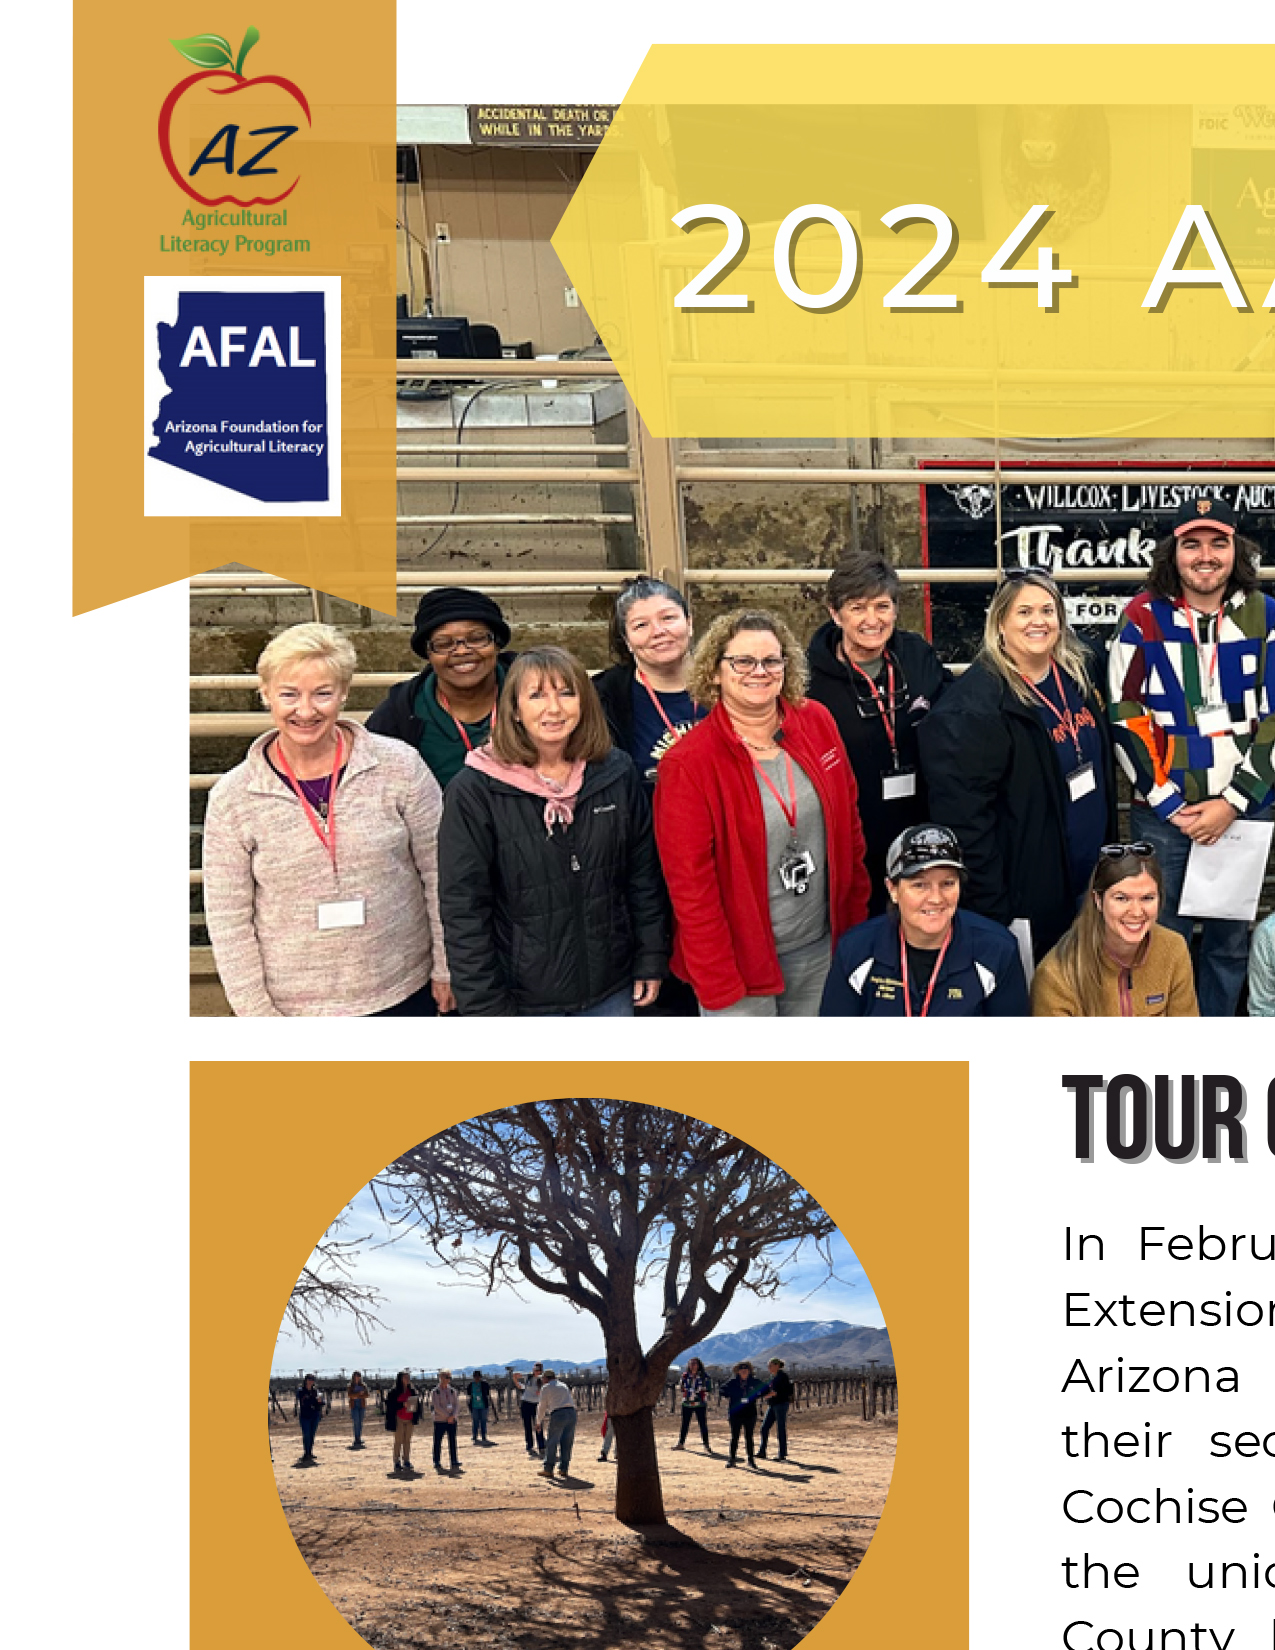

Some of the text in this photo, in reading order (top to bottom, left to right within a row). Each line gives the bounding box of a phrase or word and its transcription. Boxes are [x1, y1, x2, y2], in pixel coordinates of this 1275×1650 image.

[477, 108, 546, 120] ACCIDENTAL
[552, 109, 589, 121] DEATH
[479, 123, 520, 136] WHILE
[527, 123, 542, 136] IN
[548, 123, 573, 136] THE
[189, 124, 298, 177] AZ
[181, 209, 287, 230] Agricultural
[160, 234, 310, 256] Literacy Program
[672, 204, 1071, 308] 2024
[179, 326, 317, 367] AFAL
[164, 420, 323, 433] Arizona Foundation for
[185, 440, 325, 456] Agricultural Literacy
[1024, 484, 1112, 510] WILLCOX
[995, 523, 1157, 572] Thank
[1075, 604, 1117, 617] FOR
[1062, 1074, 1243, 1159] TOUR
[1067, 1227, 1103, 1260] In
